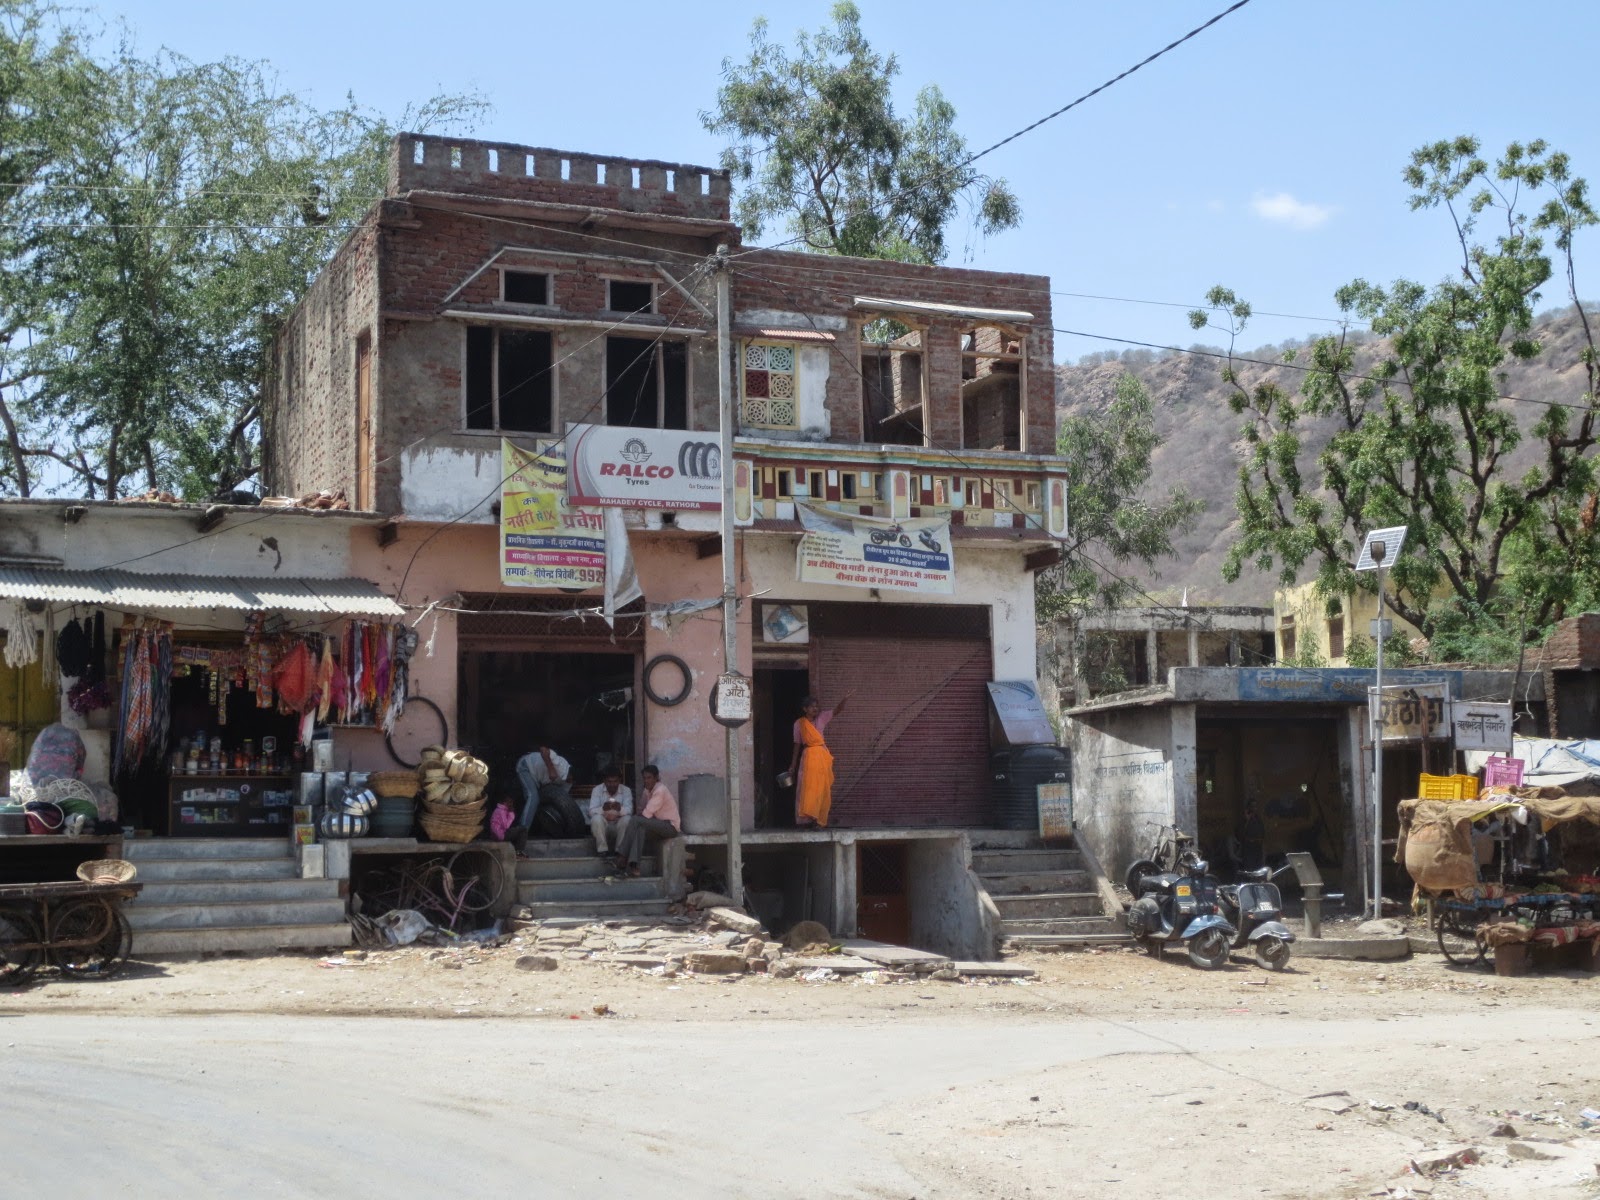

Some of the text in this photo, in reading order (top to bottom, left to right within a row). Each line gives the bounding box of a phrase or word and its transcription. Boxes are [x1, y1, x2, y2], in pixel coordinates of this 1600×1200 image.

[599, 463, 675, 479] RALCO
[625, 477, 650, 486] Tyres
[599, 498, 636, 506] MAHADEV
[638, 499, 665, 508] CYCLE,
[505, 509, 535, 528] नर्सरी
[560, 510, 603, 530] प्रवेश
[533, 567, 555, 579] दीपेन्द्र
[819, 559, 848, 571] टीवीएस
[883, 568, 899, 577] हुआ
[923, 573, 947, 581] आसान
